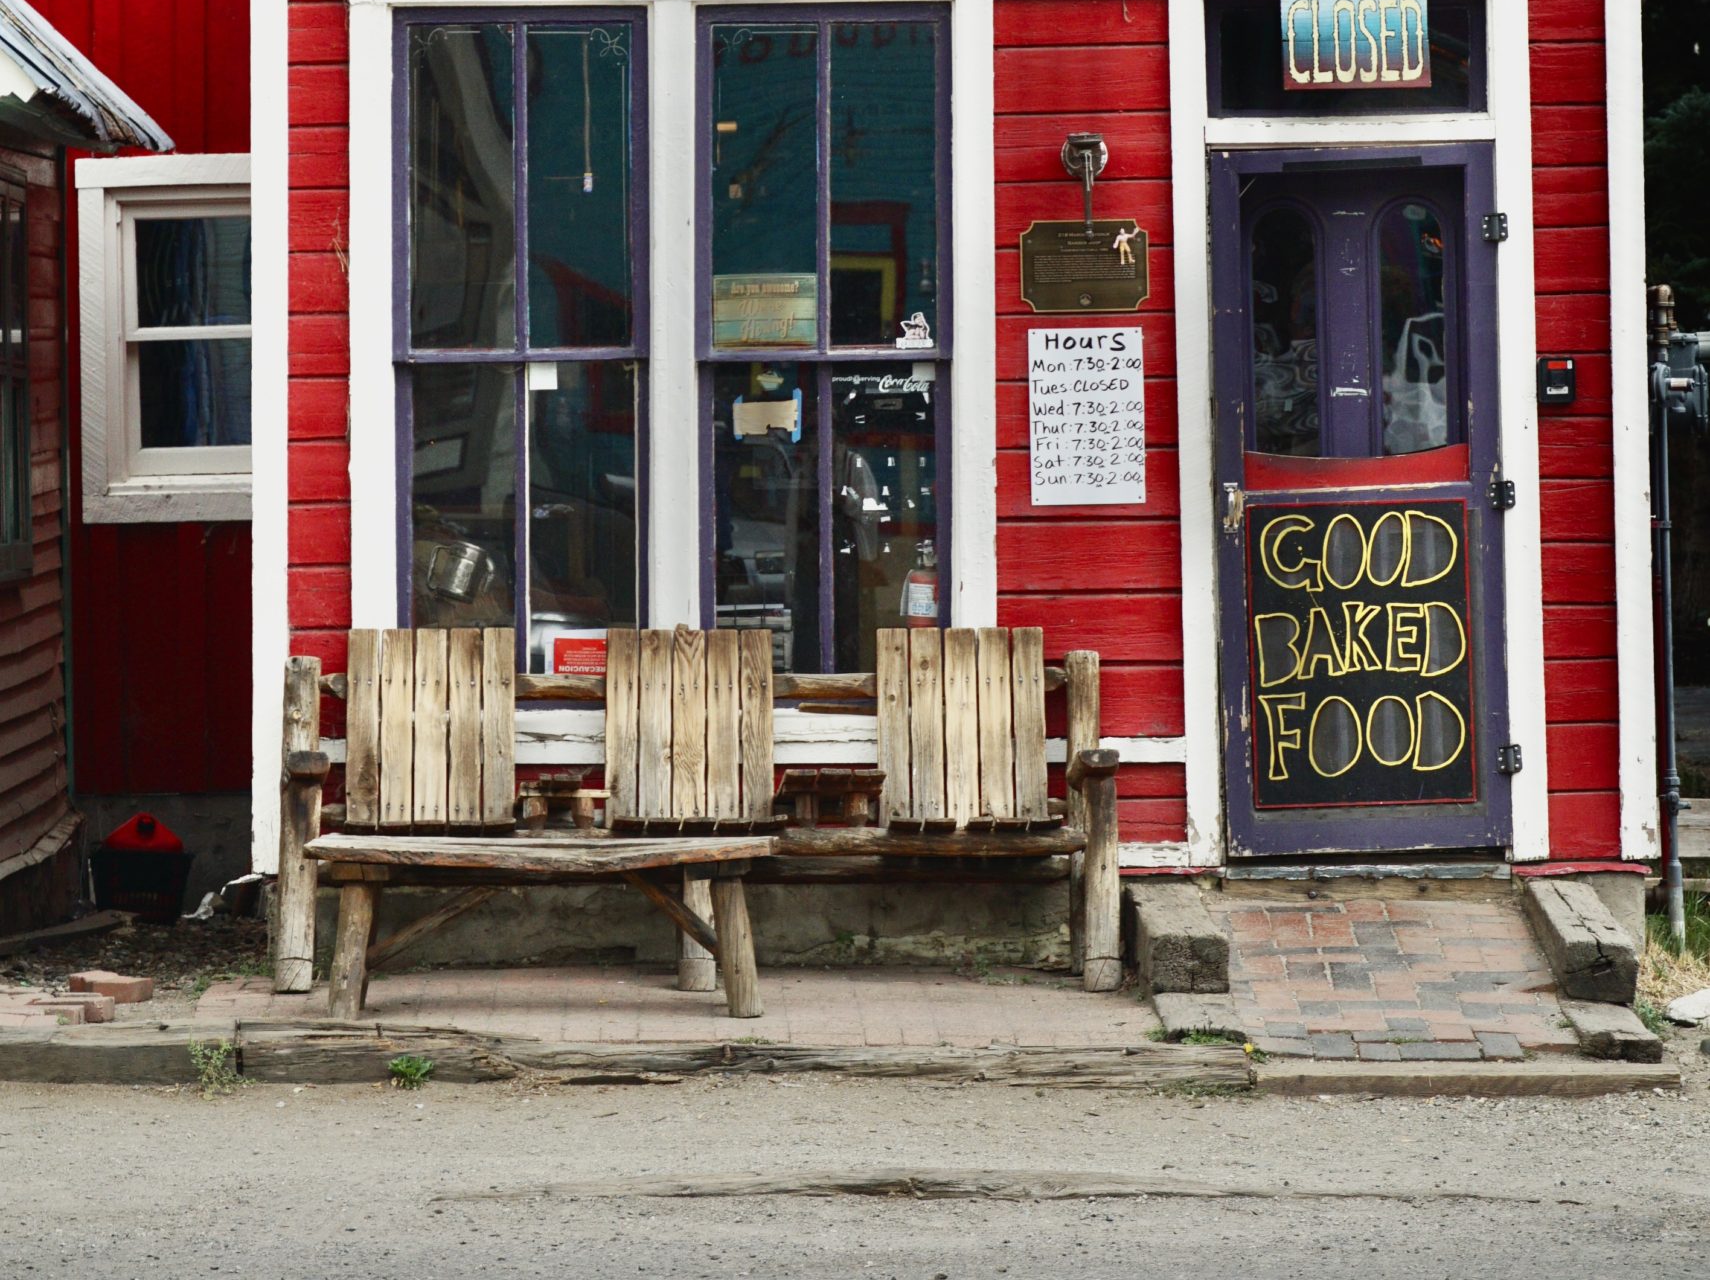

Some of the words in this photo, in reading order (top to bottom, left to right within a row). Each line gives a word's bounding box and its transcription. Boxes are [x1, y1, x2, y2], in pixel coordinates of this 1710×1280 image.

[1045, 332, 1126, 351] Hours
[879, 374, 929, 393] Coca-Cola
[1073, 378, 1130, 392] CLOSED
[1260, 510, 1458, 593] GOOD
[1254, 601, 1467, 688] BAKED
[1258, 691, 1466, 781] FOOD
